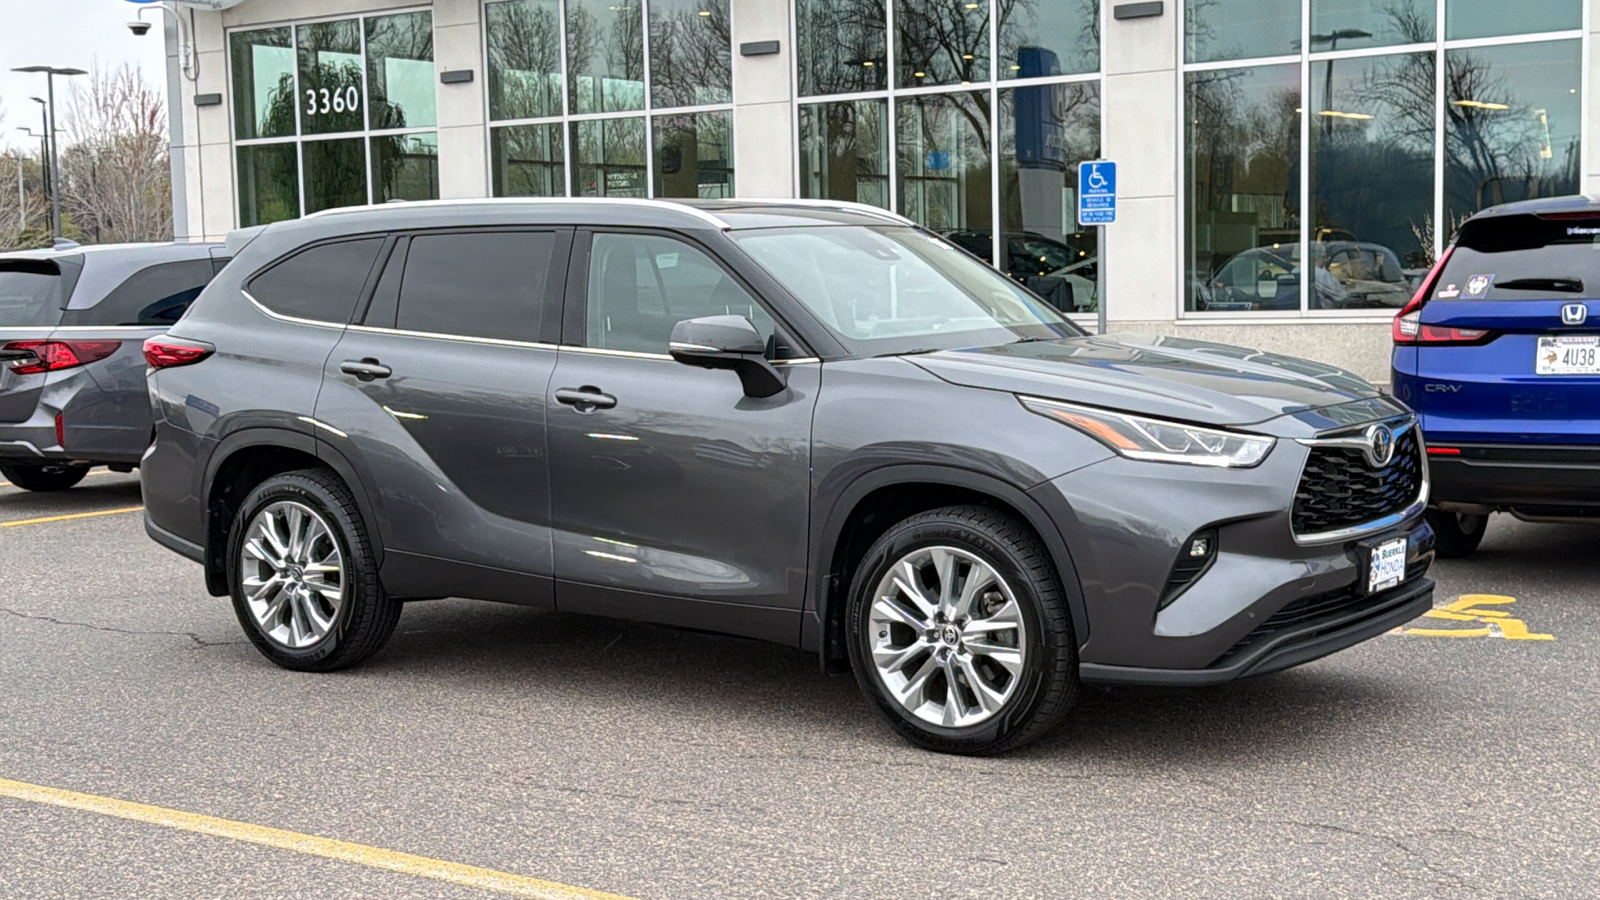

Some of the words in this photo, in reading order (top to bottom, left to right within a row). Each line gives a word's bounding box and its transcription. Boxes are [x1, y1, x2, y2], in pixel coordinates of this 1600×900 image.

[306, 85, 359, 115] 3360
[1562, 348, 1596, 367] 4U38
[1424, 383, 1463, 393] CR-V
[1380, 558, 1404, 576] HONDA
